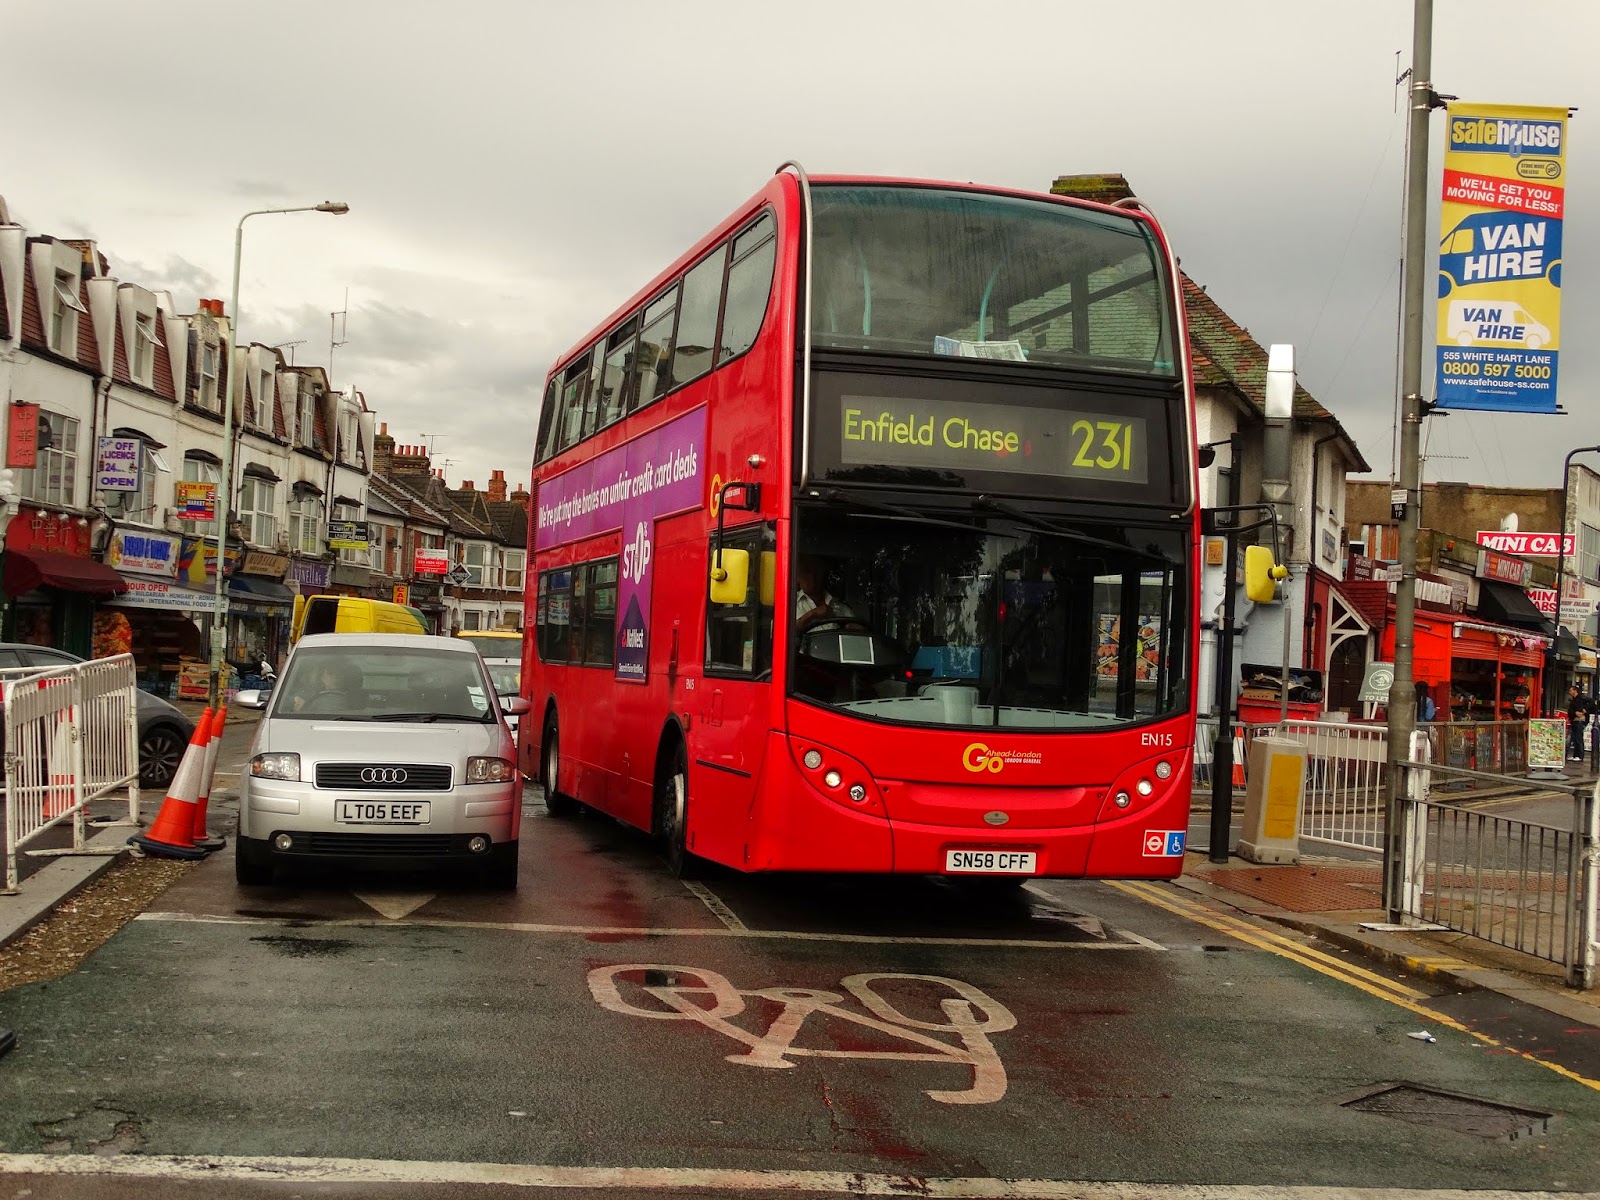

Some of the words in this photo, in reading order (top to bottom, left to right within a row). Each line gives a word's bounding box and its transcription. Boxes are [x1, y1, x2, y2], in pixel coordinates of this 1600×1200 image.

[1452, 119, 1561, 148] safehouse
[1447, 186, 1495, 202] MOVING
[1498, 194, 1522, 207] FOR
[1460, 177, 1496, 192] WE'LL
[1499, 183, 1524, 196] GET
[1526, 187, 1551, 200] YOU
[1481, 221, 1546, 250] VAN
[1463, 250, 1544, 281] HIRE
[1463, 308, 1502, 323] VAN
[1477, 324, 1525, 340] HIRE
[1443, 351, 1460, 360] 555
[1462, 352, 1494, 361] WHITE
[1496, 353, 1523, 363] HART
[1525, 355, 1551, 364] LANE
[1442, 362, 1480, 375] 0800
[1483, 363, 1511, 377] 597
[1514, 365, 1551, 379] 5000
[1443, 377, 1549, 389] www.safehouse-ss.com
[115, 442, 134, 450] OFF
[844, 408, 934, 447] Enfield
[942, 416, 1019, 453] Chase
[1071, 419, 1132, 471] 231
[104, 450, 136, 459] LICENCE
[105, 462, 116, 472] 24
[600, 486, 609, 507] on
[609, 470, 631, 504] unfair
[632, 461, 653, 498] credit
[654, 451, 673, 489] card
[673, 443, 697, 482] deals
[101, 477, 135, 486] OPEN
[1482, 535, 1529, 552] MINI
[1530, 537, 1572, 553] CAB
[1497, 558, 1511, 578] MINI
[1510, 562, 1521, 582] CAB
[136, 590, 165, 598] BULGARIAN
[147, 584, 169, 592] OPEN
[149, 598, 191, 607] INTERNATIONAL
[1534, 601, 1558, 613] ABS
[1141, 733, 1173, 747] EN15
[963, 742, 1004, 774] Go
[986, 749, 1042, 759] Ahead-London
[343, 803, 386, 819] LT05
[391, 804, 423, 820] EEF
[952, 852, 994, 869] SN58
[998, 853, 1030, 870] CFF
